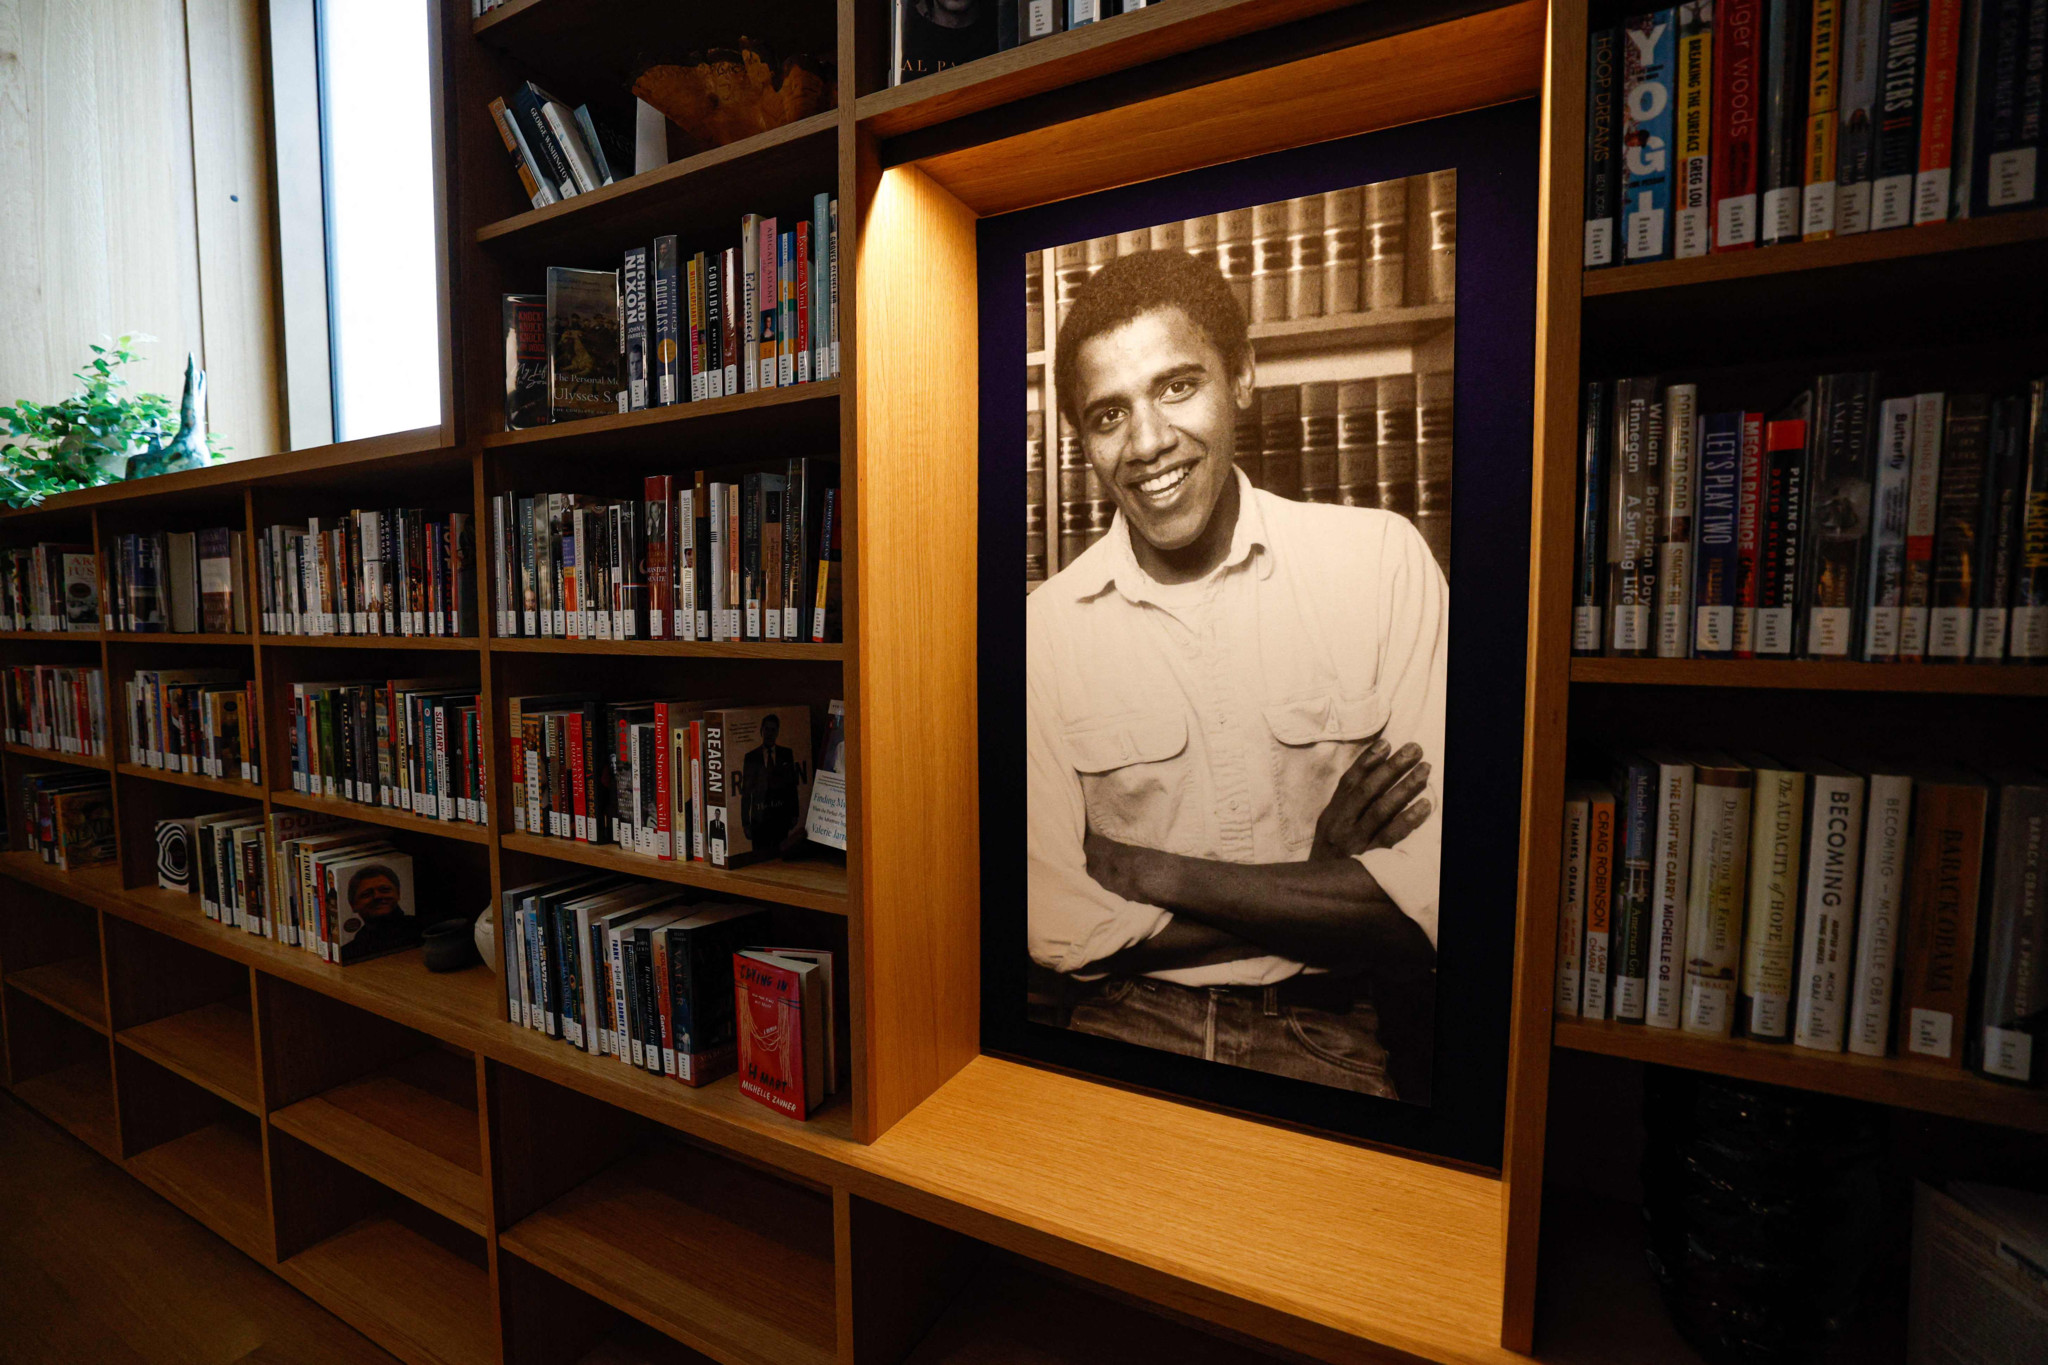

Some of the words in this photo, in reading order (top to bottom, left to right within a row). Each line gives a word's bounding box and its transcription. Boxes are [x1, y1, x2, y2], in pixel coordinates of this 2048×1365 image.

[1595, 37, 1613, 88] HOOP
[1688, 39, 1702, 88] BREAKING
[1883, 16, 1919, 112] MONSTERS
[1688, 89, 1701, 110] THE
[530, 108, 550, 137] GEORGE
[1593, 92, 1611, 162] DREAMS
[1687, 111, 1700, 152] SURFACE
[1689, 158, 1703, 186] GREG
[626, 255, 637, 324] NIXON
[637, 254, 646, 322] RICHARD
[657, 279, 668, 333] DOUGLASS
[709, 266, 718, 322] COOLIDGE
[799, 282, 807, 309] Wind
[554, 388, 599, 403] Ulysses
[603, 390, 613, 403] S.
[555, 374, 568, 382] The
[571, 375, 604, 384] Personal
[1625, 398, 1644, 473] Finnegan
[1648, 403, 1663, 466] William
[1705, 432, 1735, 470] LET'S
[1741, 421, 1760, 478] MEGAN
[1891, 413, 1908, 470] Butterfly
[1627, 496, 1641, 507] A
[1704, 474, 1734, 509] PLAY
[1786, 467, 1800, 531] PLAYING
[1644, 486, 1660, 568] Barbarian
[1702, 513, 1733, 544] TWO
[1739, 481, 1757, 551] RAPINOE
[1621, 511, 1642, 570] Surfing
[1785, 538, 1796, 566] FOR
[1622, 576, 1639, 604] Life
[435, 712, 444, 752] SOLITARY
[657, 713, 665, 751] Cheryl
[657, 754, 665, 794] Strayed
[707, 728, 722, 792] REAGAN
[814, 792, 835, 808] Finding
[1634, 775, 1648, 817] Michelle
[1670, 778, 1681, 799] THE
[1778, 778, 1793, 799] The
[812, 823, 831, 836] Valerie
[1570, 817, 1580, 862] THANKS,
[1597, 810, 1610, 853] CRAIG
[1668, 803, 1680, 838] LIGHT
[1772, 800, 1791, 877] AUDACITY
[1880, 798, 1900, 877] BECOMING
[1667, 840, 1678, 858] WE
[1822, 792, 1850, 907] BECOMING
[1568, 867, 1577, 903] OBAMA
[1594, 856, 1608, 928] ROBINSON
[1664, 861, 1677, 901] CARRY
[1768, 883, 1786, 898] of
[1629, 907, 1641, 956] American
[1660, 904, 1674, 962] MICHELLE
[1768, 900, 1784, 941] HOPE
[1873, 898, 1890, 970] MICHELLE
[741, 1080, 771, 1101] MICHELLE
[772, 1095, 796, 1112] ZAUNER
[760, 1072, 787, 1093] MART
